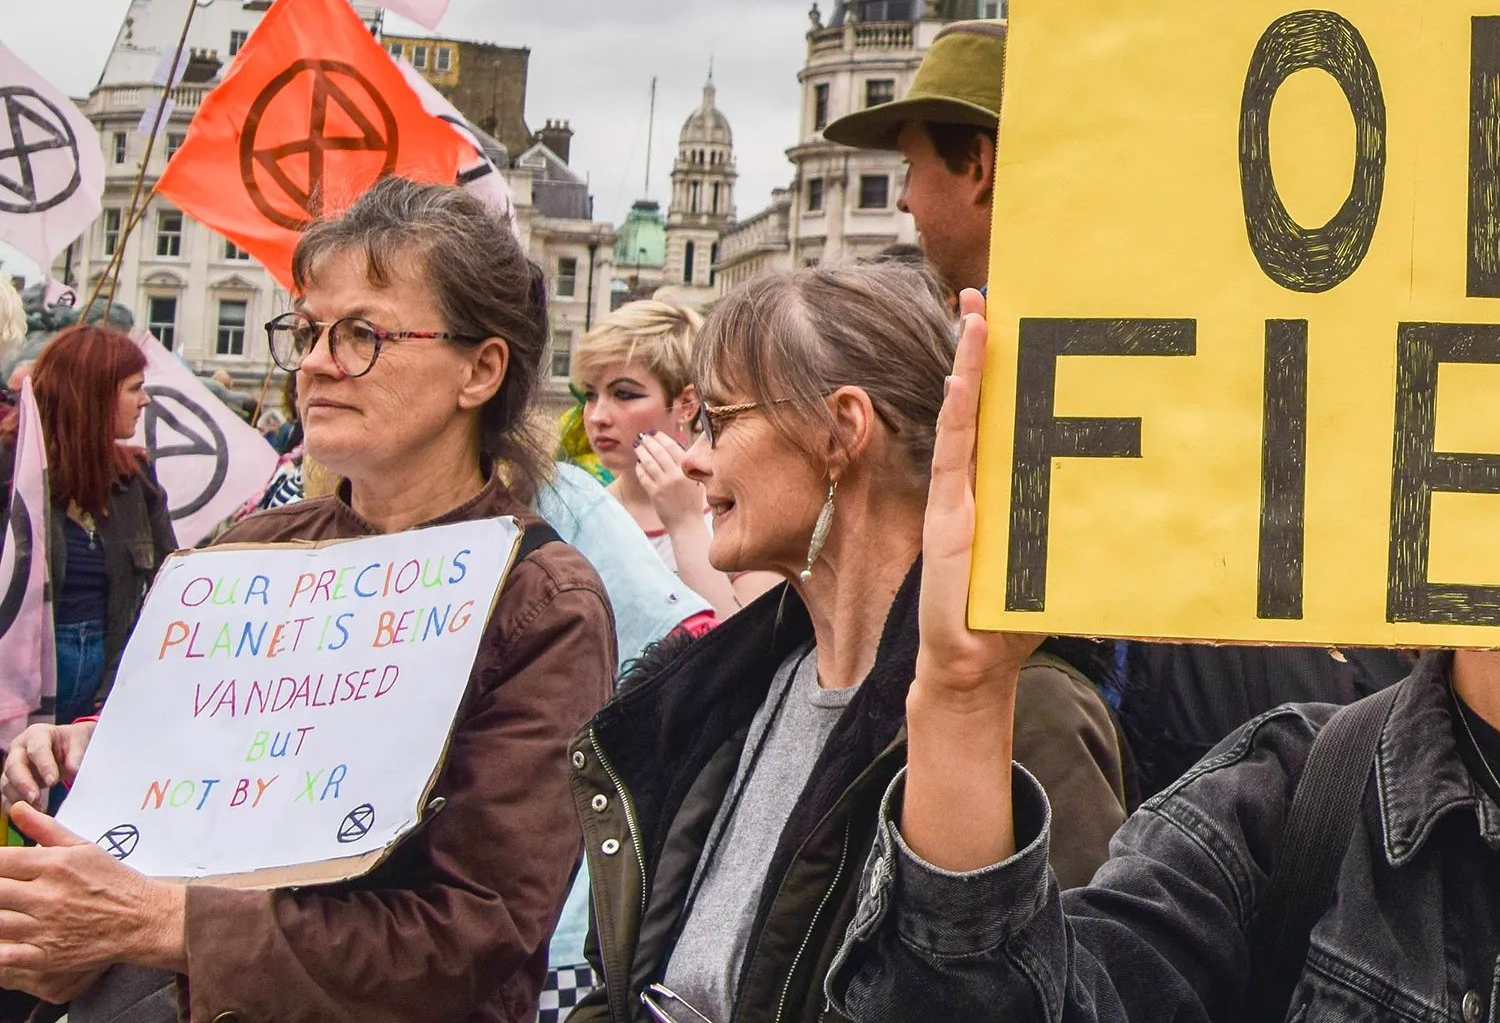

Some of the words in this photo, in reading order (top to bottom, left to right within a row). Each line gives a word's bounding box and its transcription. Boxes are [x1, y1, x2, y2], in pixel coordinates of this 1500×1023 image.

[181, 575, 270, 607] OUR
[289, 549, 471, 608] PRECIOUS
[158, 616, 314, 660] PLANET
[316, 612, 354, 652] IS
[372, 599, 476, 648] BEING
[193, 665, 399, 718] VANDALISED
[245, 726, 315, 762] BUT
[141, 779, 220, 810] NOT
[230, 774, 280, 808] BY
[293, 764, 347, 802] XR
